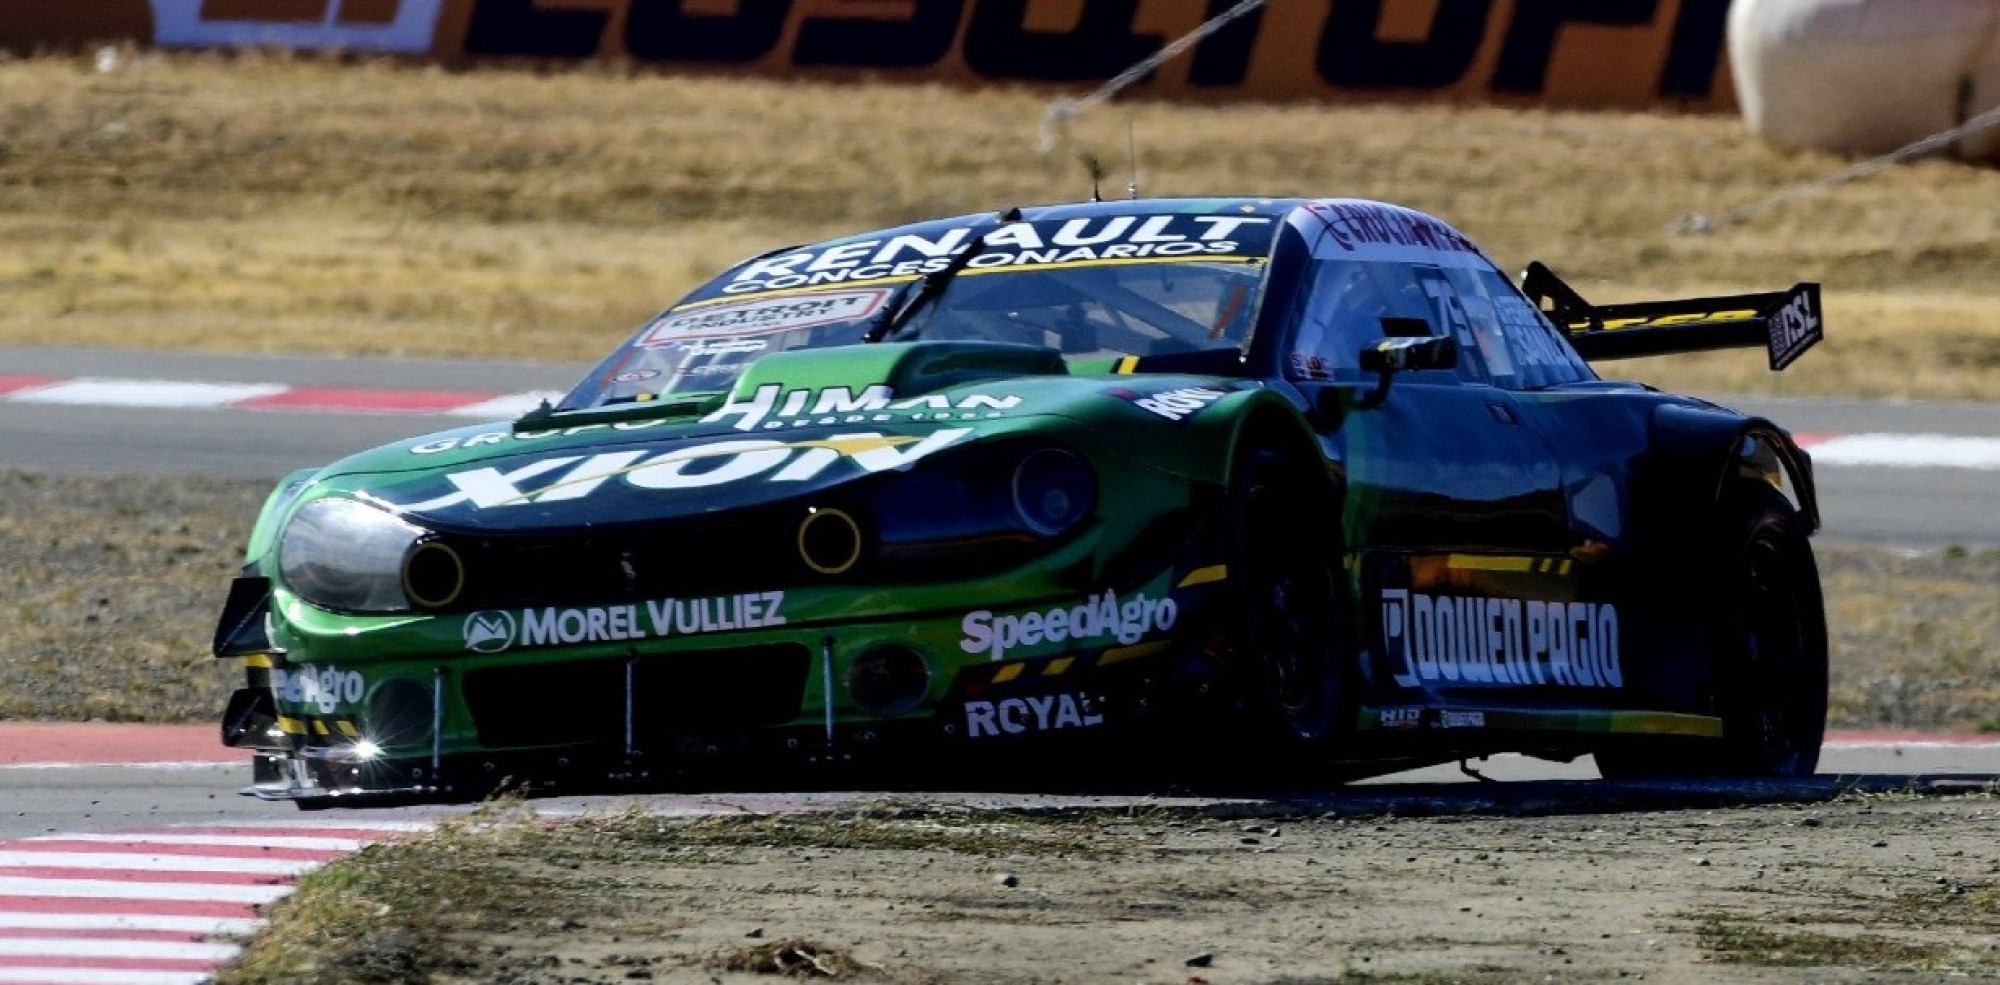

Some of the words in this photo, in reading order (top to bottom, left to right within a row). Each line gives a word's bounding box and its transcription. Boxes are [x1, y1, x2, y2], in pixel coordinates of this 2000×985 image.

[723, 240, 1239, 293] CONCESONARIOS
[735, 215, 1271, 282] RENAULT
[670, 296, 863, 328] DETROIT
[699, 384, 1024, 431] HIMAN
[397, 427, 973, 510] XION
[521, 603, 645, 646] MOREL
[645, 590, 786, 637] VULLIEZ
[959, 587, 1178, 662] SpeedAgro
